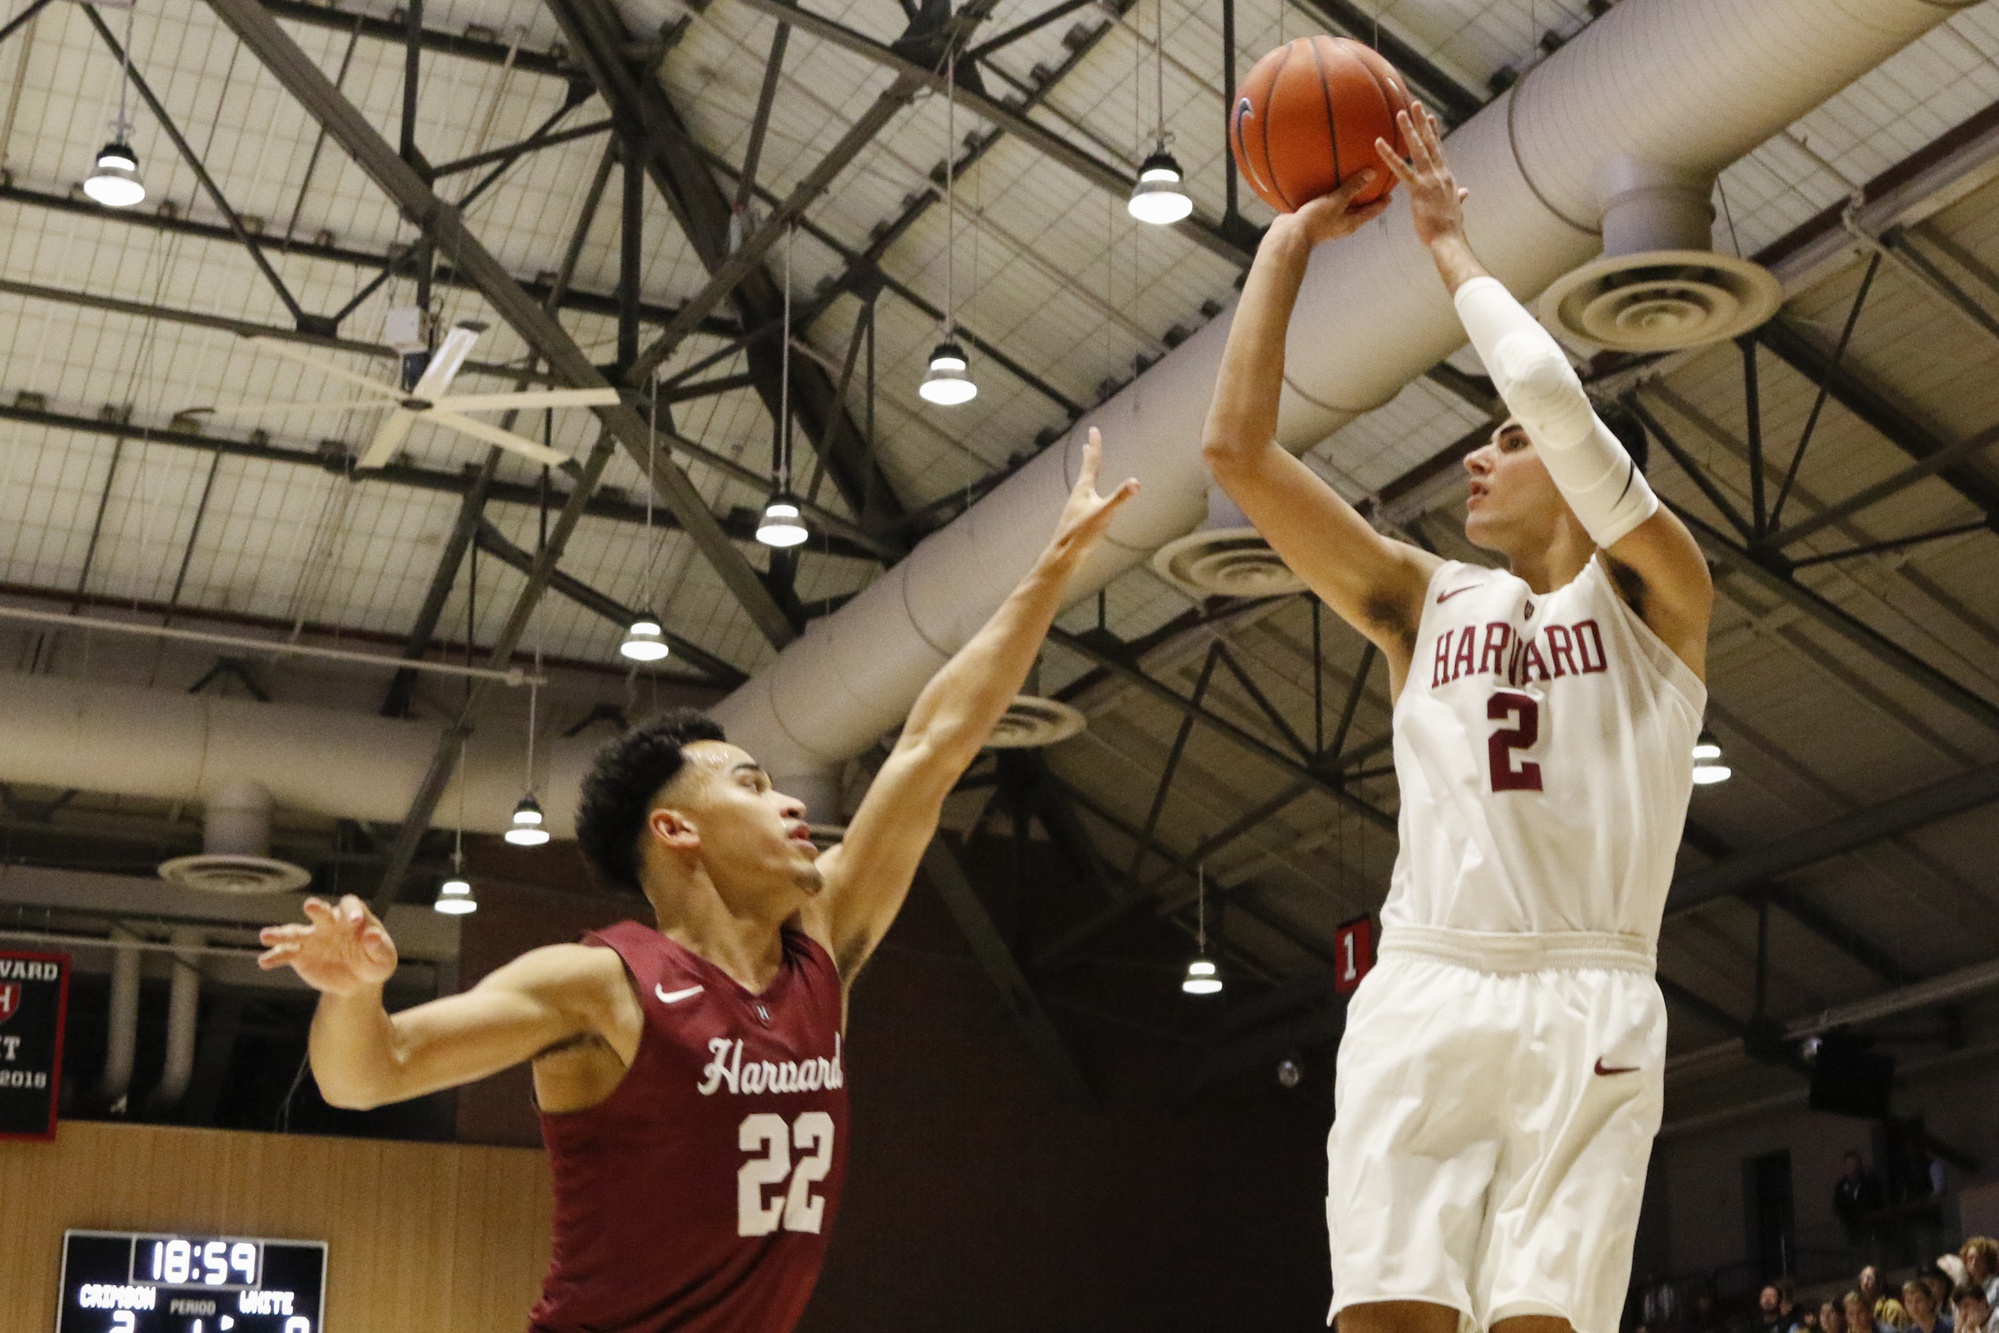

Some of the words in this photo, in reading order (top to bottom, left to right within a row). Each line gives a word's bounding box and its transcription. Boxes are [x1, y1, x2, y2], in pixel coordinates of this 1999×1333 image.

[1431, 618, 1609, 689] HARVARD
[1487, 691, 1544, 793] 2
[0, 959, 59, 981] VARD
[1343, 931, 1357, 983] 1
[697, 1031, 844, 1096] Harvard
[737, 1111, 835, 1237] 22
[152, 1239, 256, 1285] 18:59
[79, 1283, 157, 1311] CRIMSON
[169, 1298, 217, 1316] PERIOD
[238, 1289, 295, 1316] WHITE
